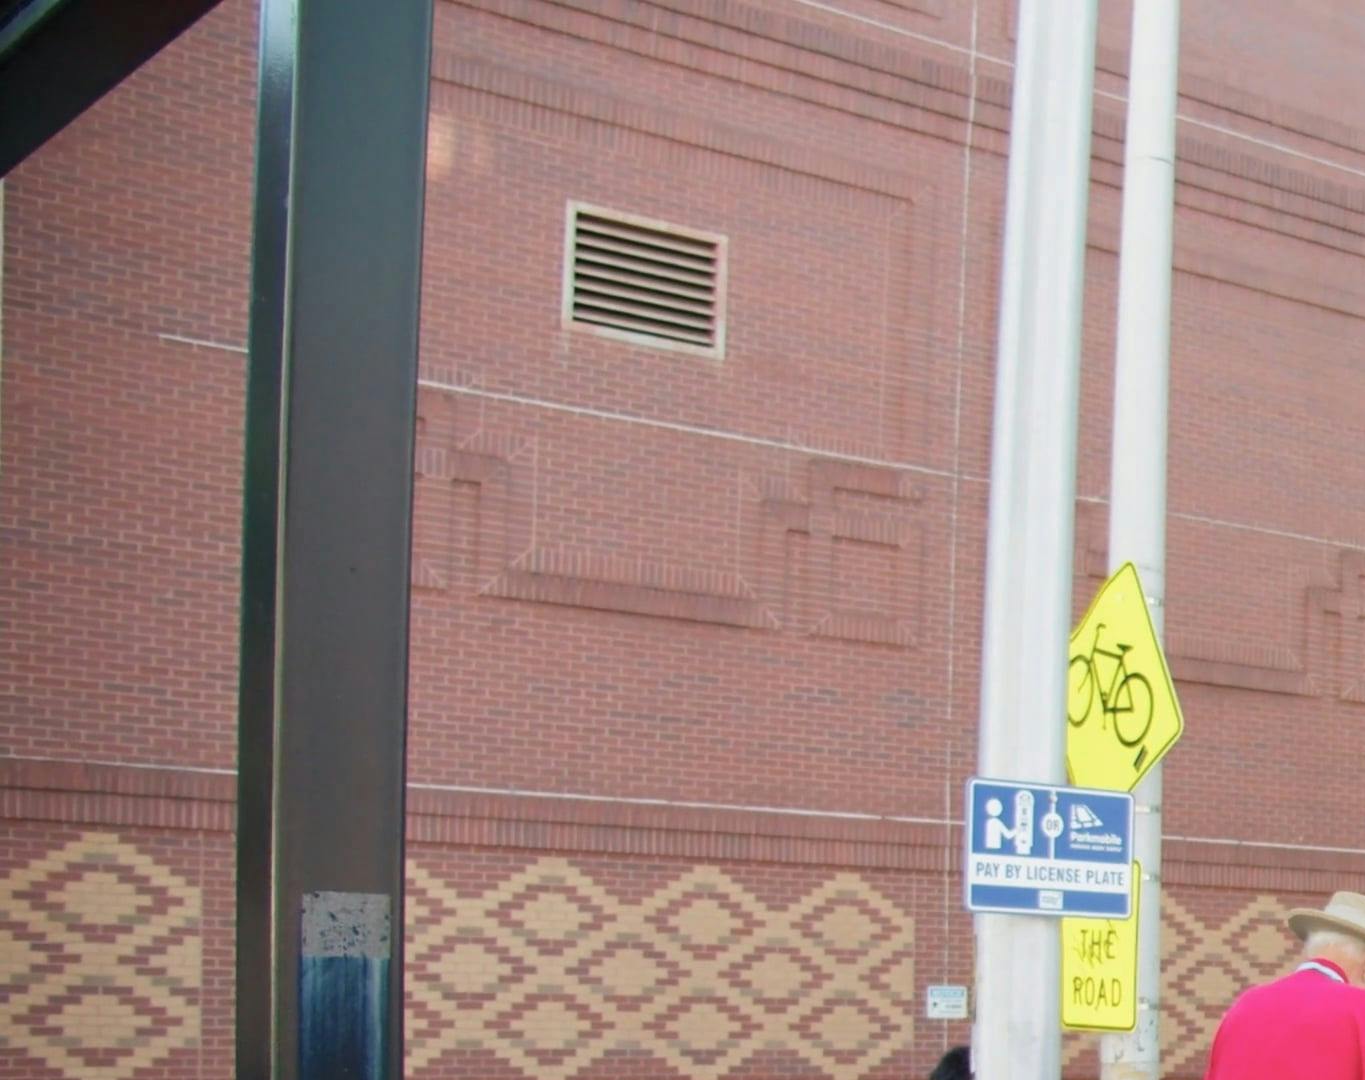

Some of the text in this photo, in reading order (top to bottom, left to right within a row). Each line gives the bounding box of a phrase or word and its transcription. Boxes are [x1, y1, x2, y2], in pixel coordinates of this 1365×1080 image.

[1045, 818, 1059, 831] OR
[976, 861, 1125, 886] PAY BY LICENSE PLATE
[1080, 929, 1117, 962] THE
[1073, 976, 1121, 1007] ROAD
